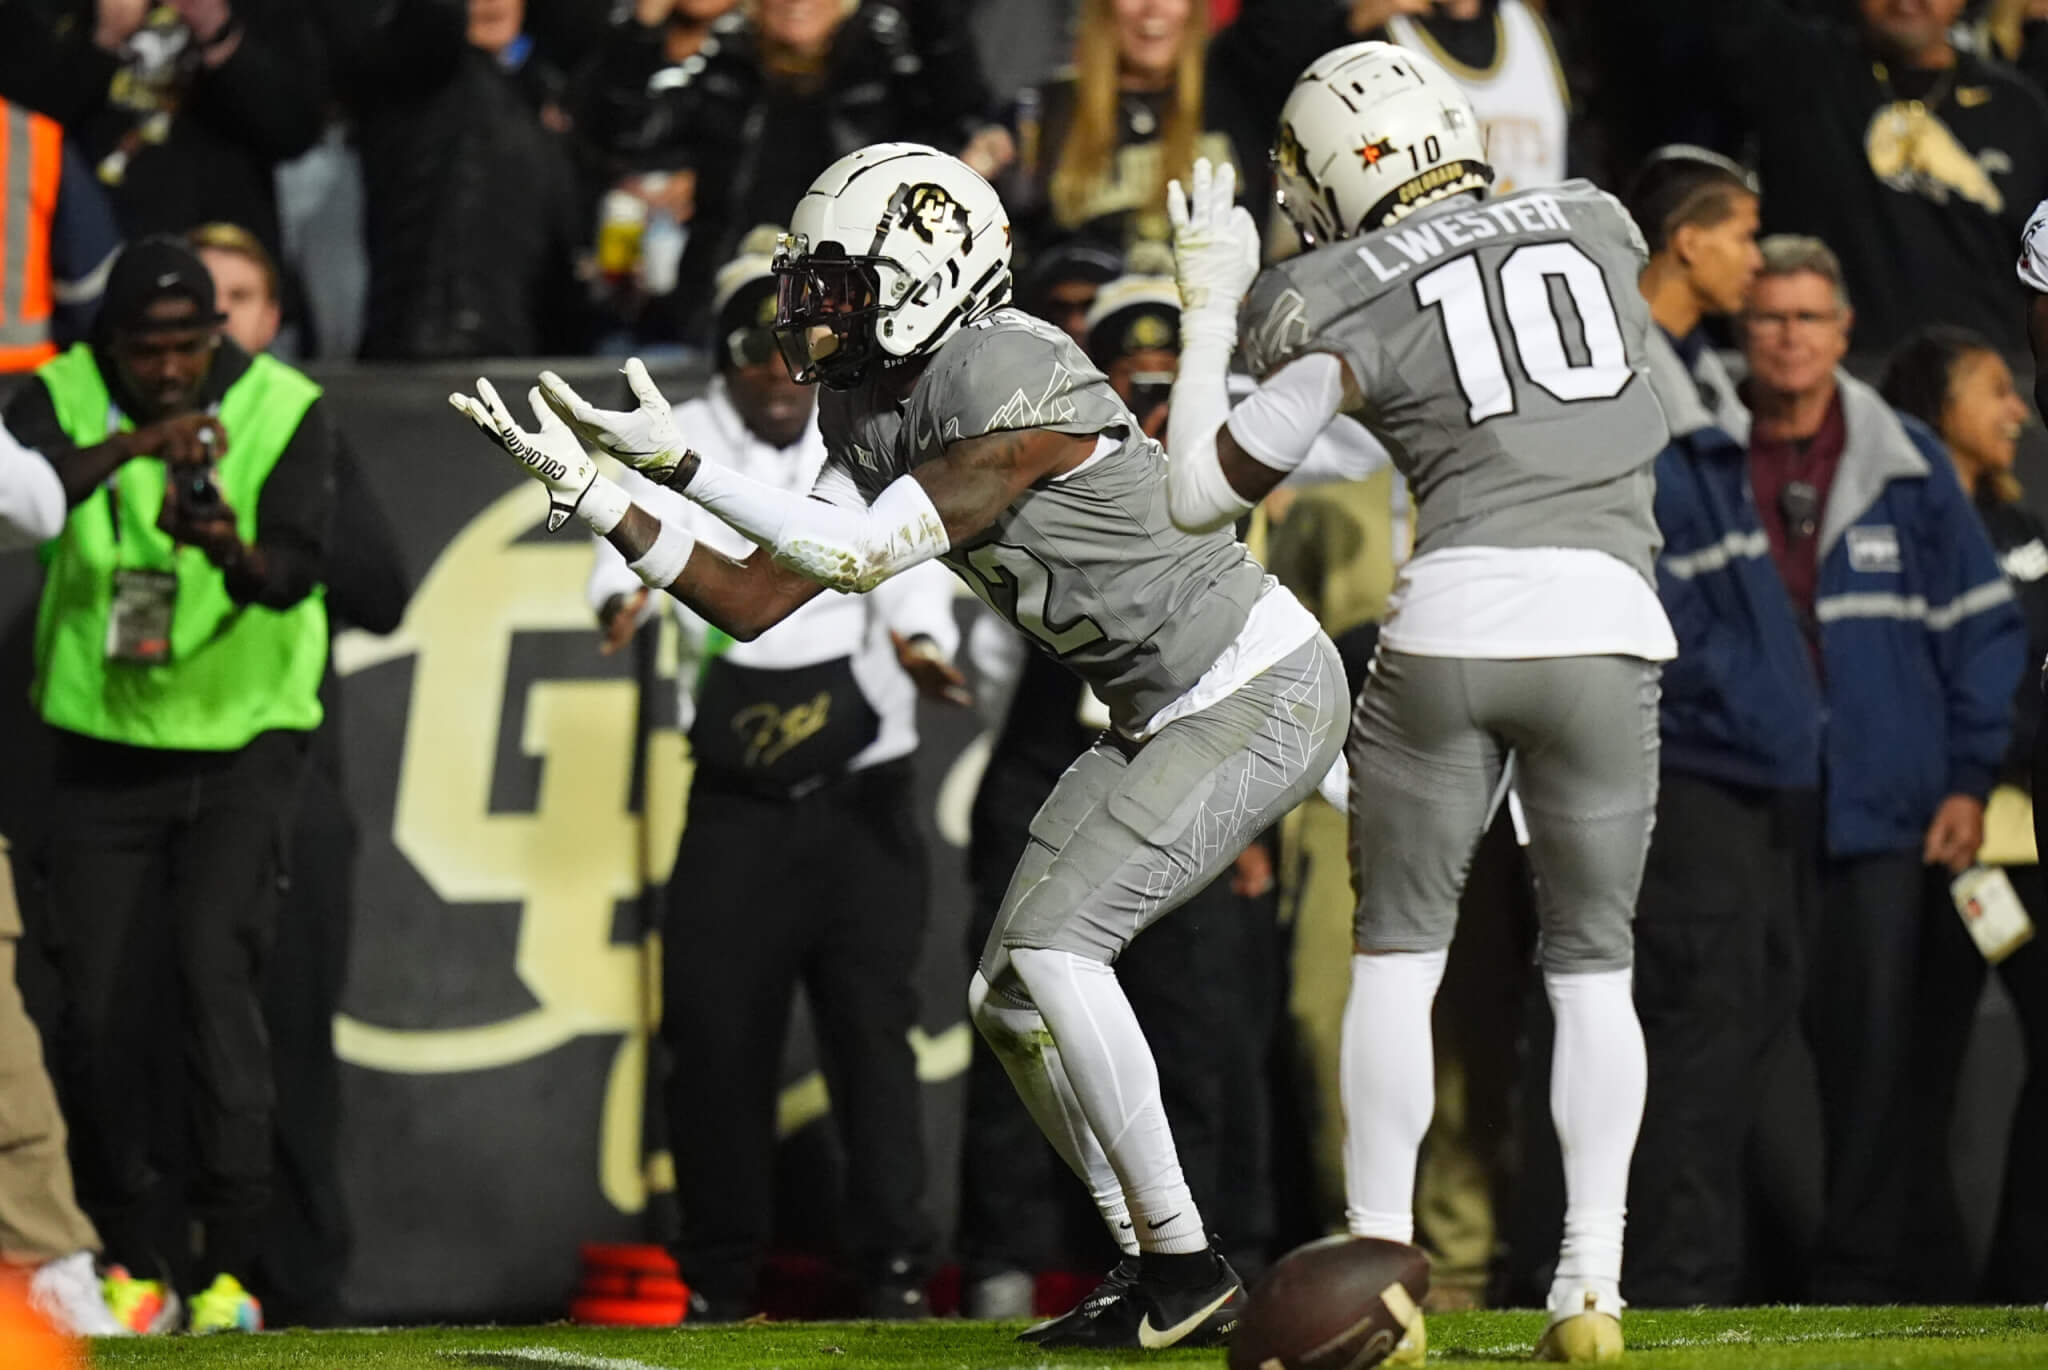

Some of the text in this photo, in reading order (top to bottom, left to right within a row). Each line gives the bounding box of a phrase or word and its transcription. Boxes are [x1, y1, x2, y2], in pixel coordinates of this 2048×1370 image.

[1408, 135, 1441, 172] 10
[1357, 193, 1572, 283] L.WESTER
[1411, 239, 1637, 429] 10
